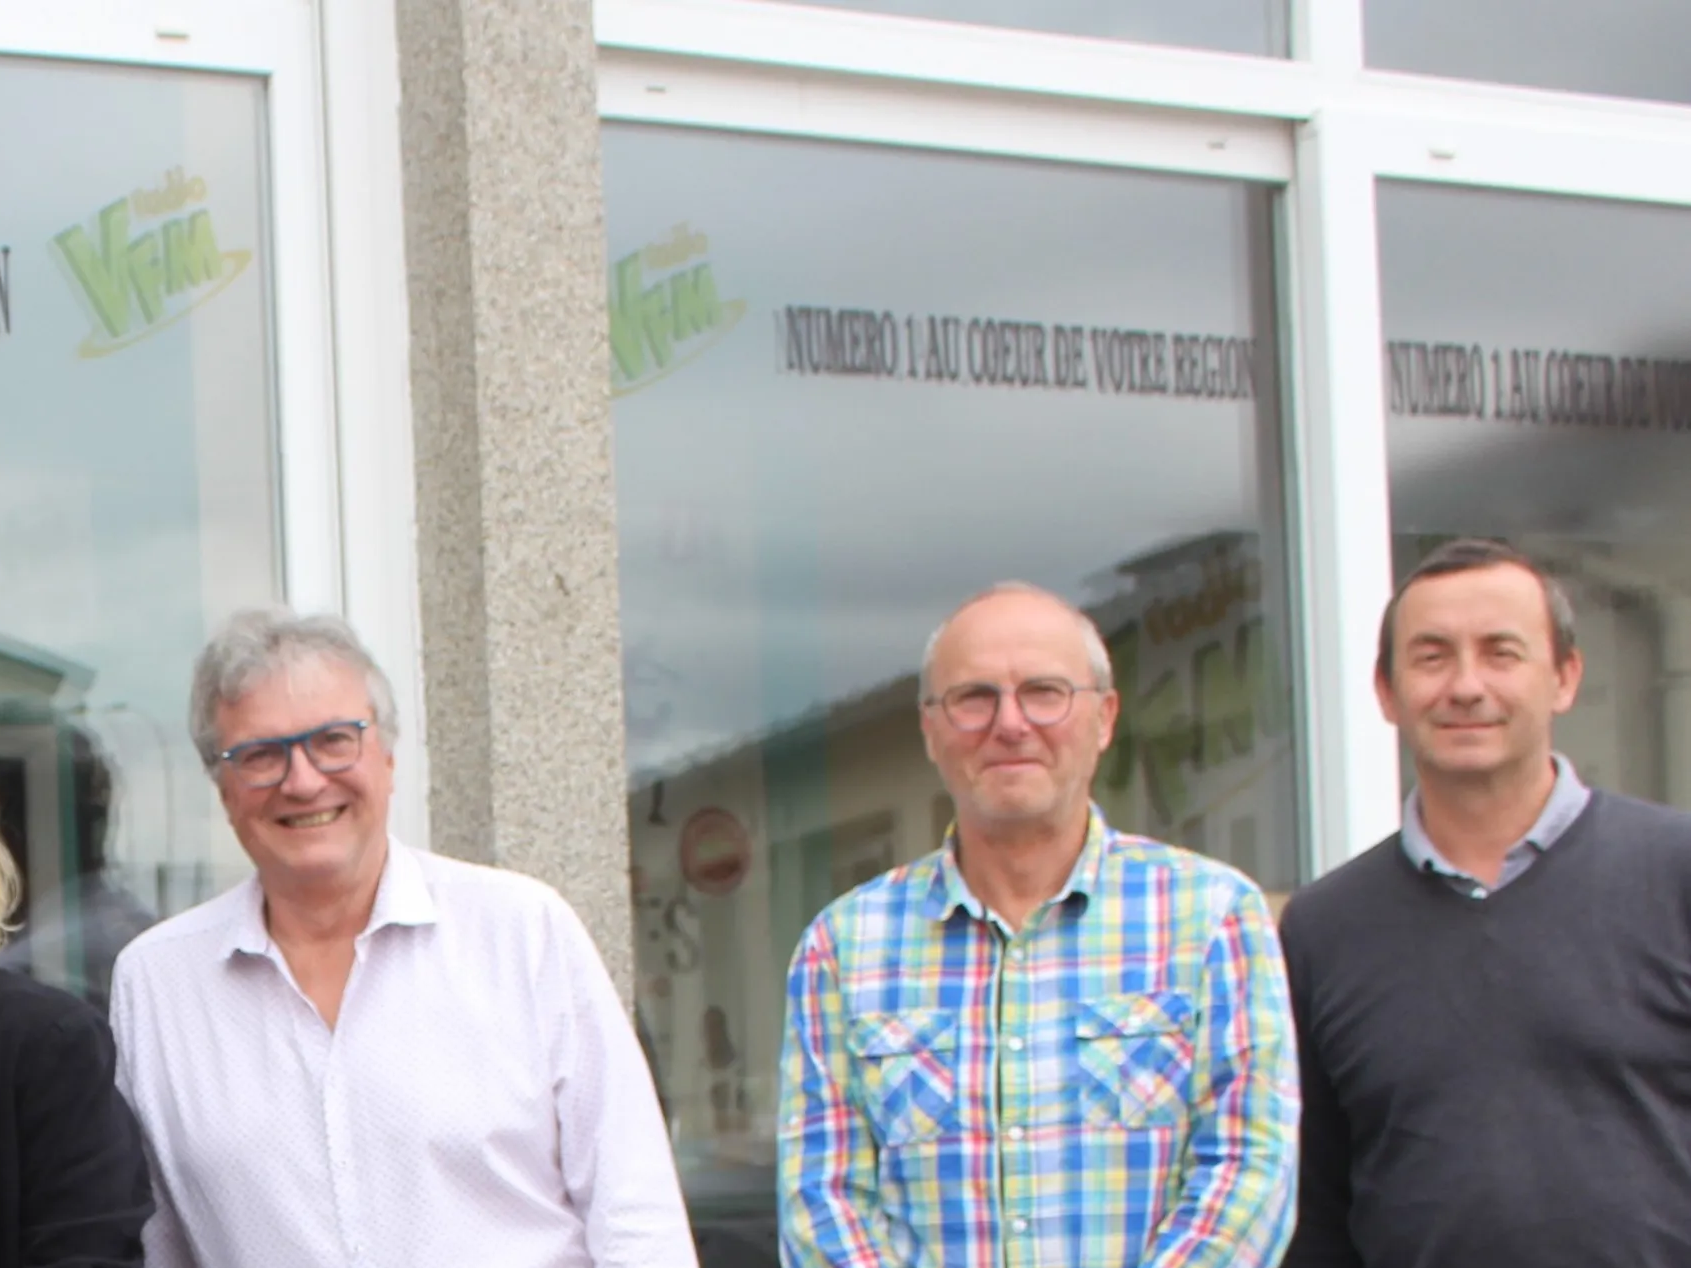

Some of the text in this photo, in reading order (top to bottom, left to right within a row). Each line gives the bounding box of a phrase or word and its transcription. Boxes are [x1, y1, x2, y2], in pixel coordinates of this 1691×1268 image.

[785, 304, 1258, 400] NUMERO 1 AU COEUR DE VOTRE REGION
[1387, 340, 1486, 420] NUMERO
[1491, 347, 1504, 421] 1
[1510, 347, 1542, 422] AU
[1545, 347, 1615, 428] COEUR
